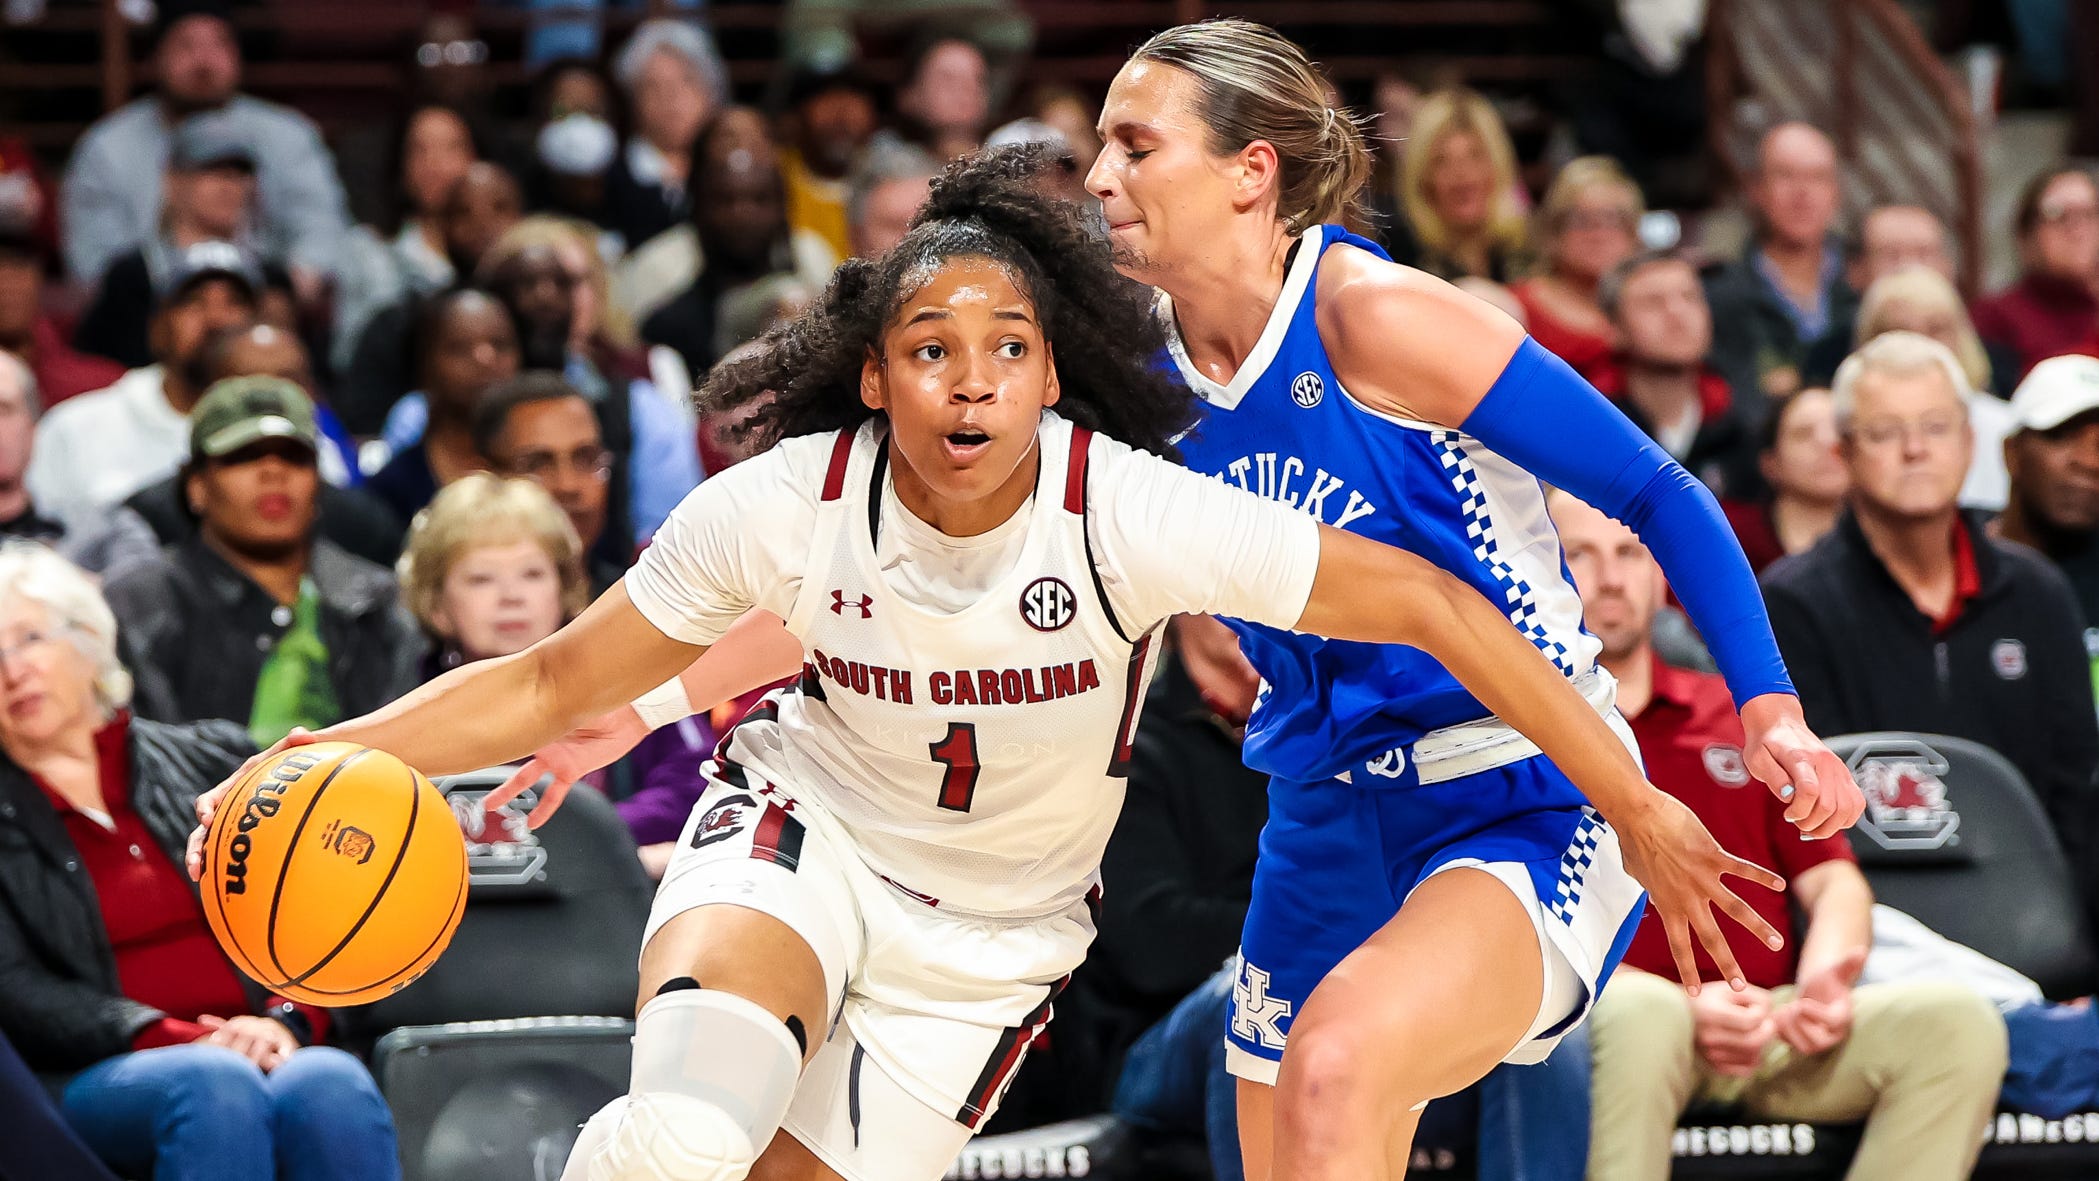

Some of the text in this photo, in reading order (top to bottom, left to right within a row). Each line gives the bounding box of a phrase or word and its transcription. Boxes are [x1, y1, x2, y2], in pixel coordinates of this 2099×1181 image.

[1293, 373, 1322, 407] SEC
[1213, 452, 1377, 529] TUCKY
[1024, 579, 1073, 629] SEC
[813, 648, 1101, 705] SOUTH CAROLINA
[928, 721, 982, 814] 1
[225, 752, 323, 896] Wilson
